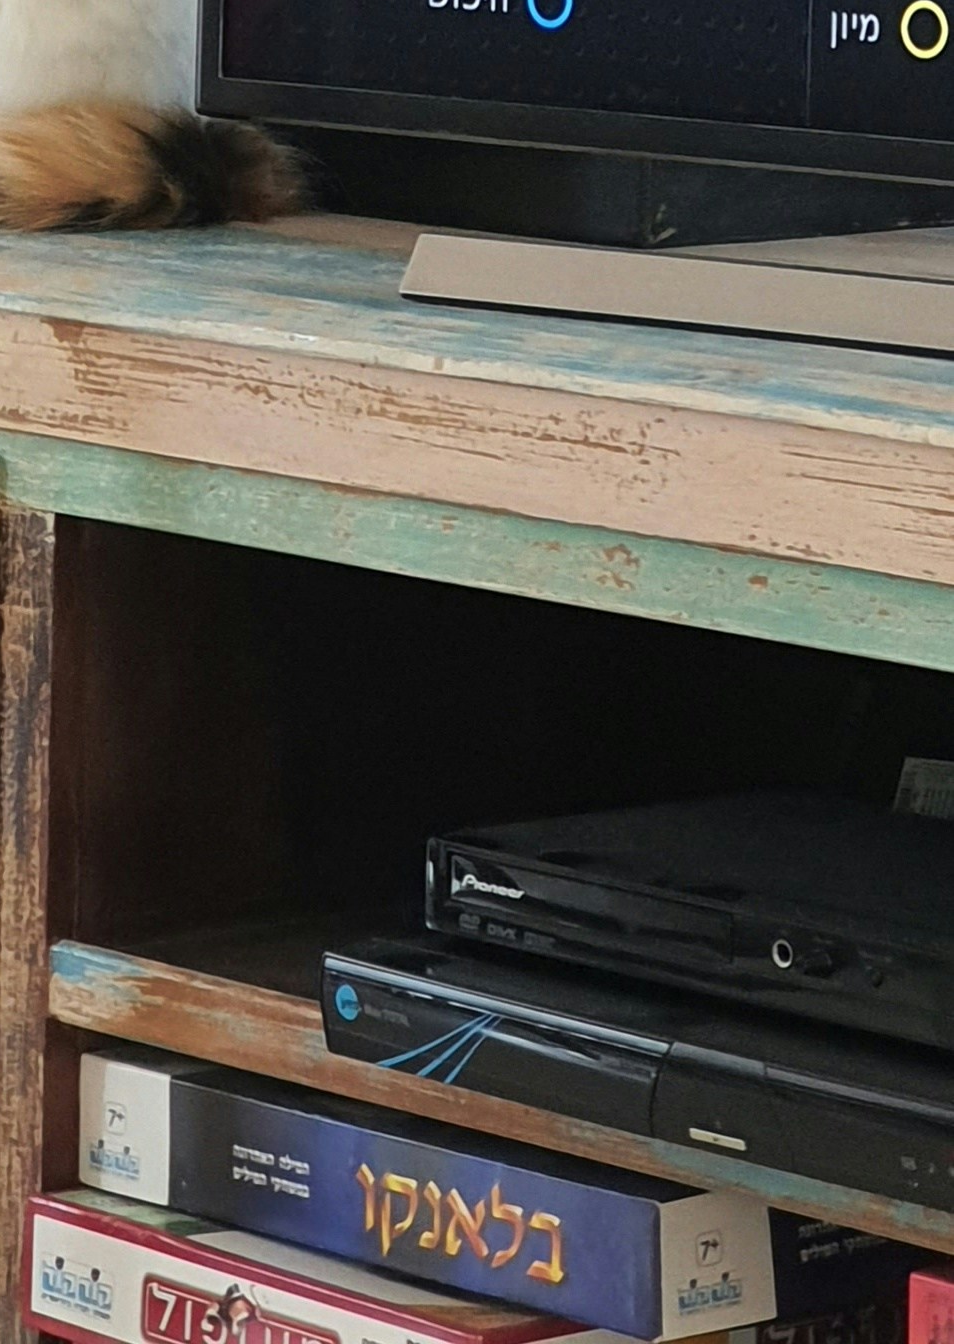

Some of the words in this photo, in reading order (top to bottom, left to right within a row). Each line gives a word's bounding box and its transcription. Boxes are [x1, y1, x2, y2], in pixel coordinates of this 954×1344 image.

[829, 8, 881, 50] מיון
[461, 873, 527, 900] Pioneer
[355, 1162, 565, 1285] בלאנקו
